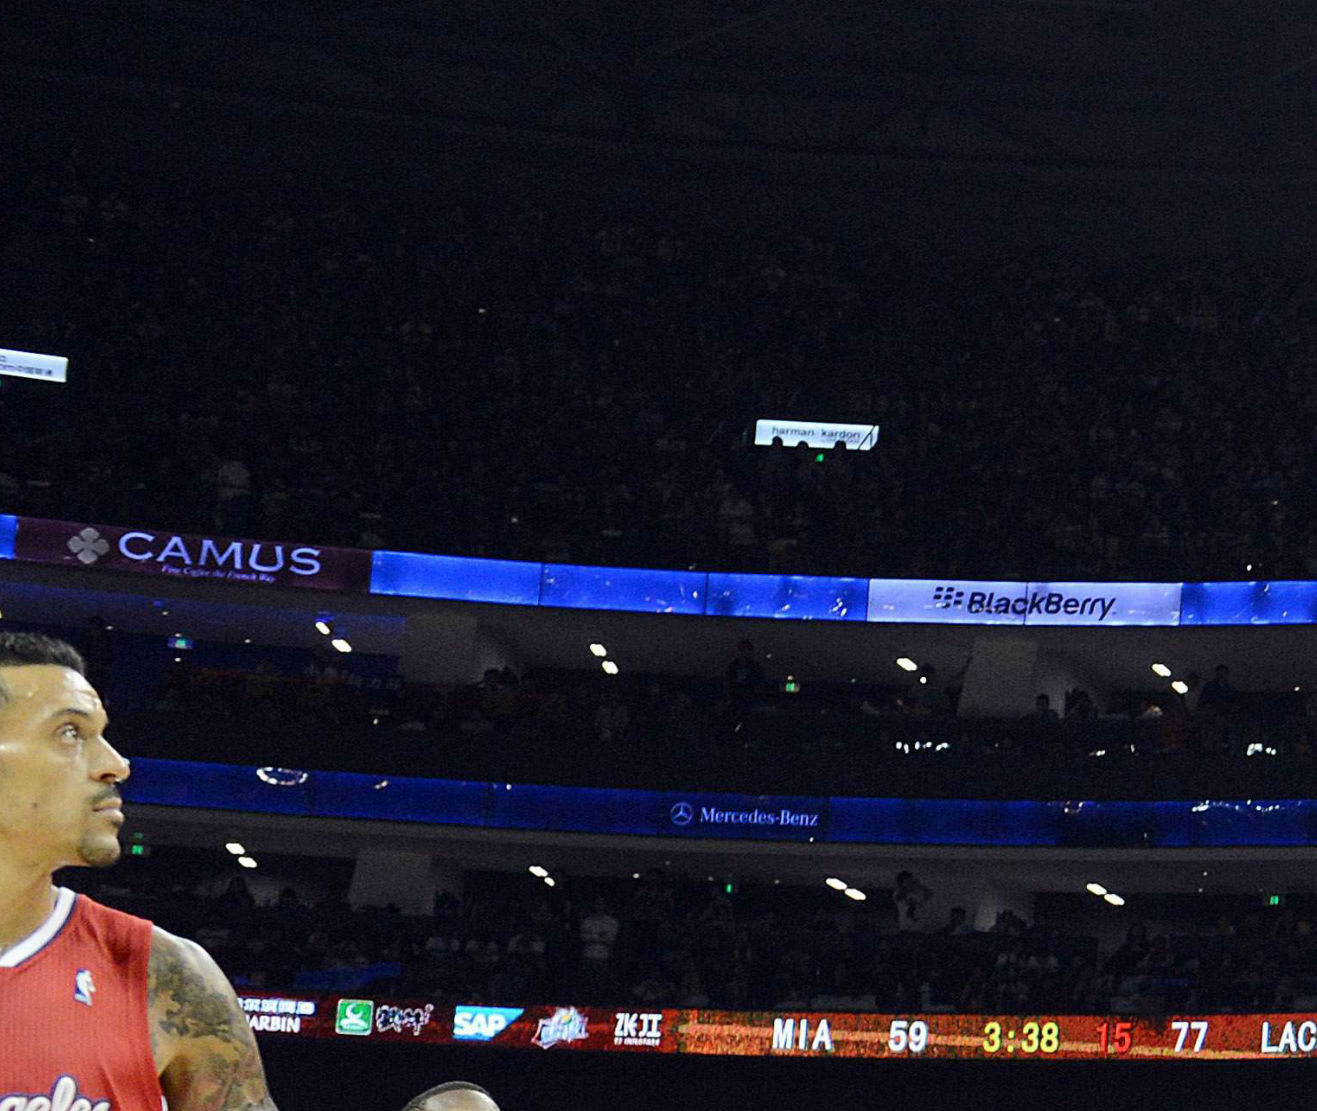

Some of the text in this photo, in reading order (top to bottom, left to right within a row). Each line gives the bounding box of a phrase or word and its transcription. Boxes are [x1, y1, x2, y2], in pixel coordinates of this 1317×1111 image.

[118, 530, 321, 575] CAMUS
[967, 591, 1116, 620] BlackBerry
[700, 807, 820, 826] Mercedes-Benz
[454, 1012, 507, 1037] SAP
[772, 1017, 1317, 1054] MIA 59 3:38 15 77 LAC
